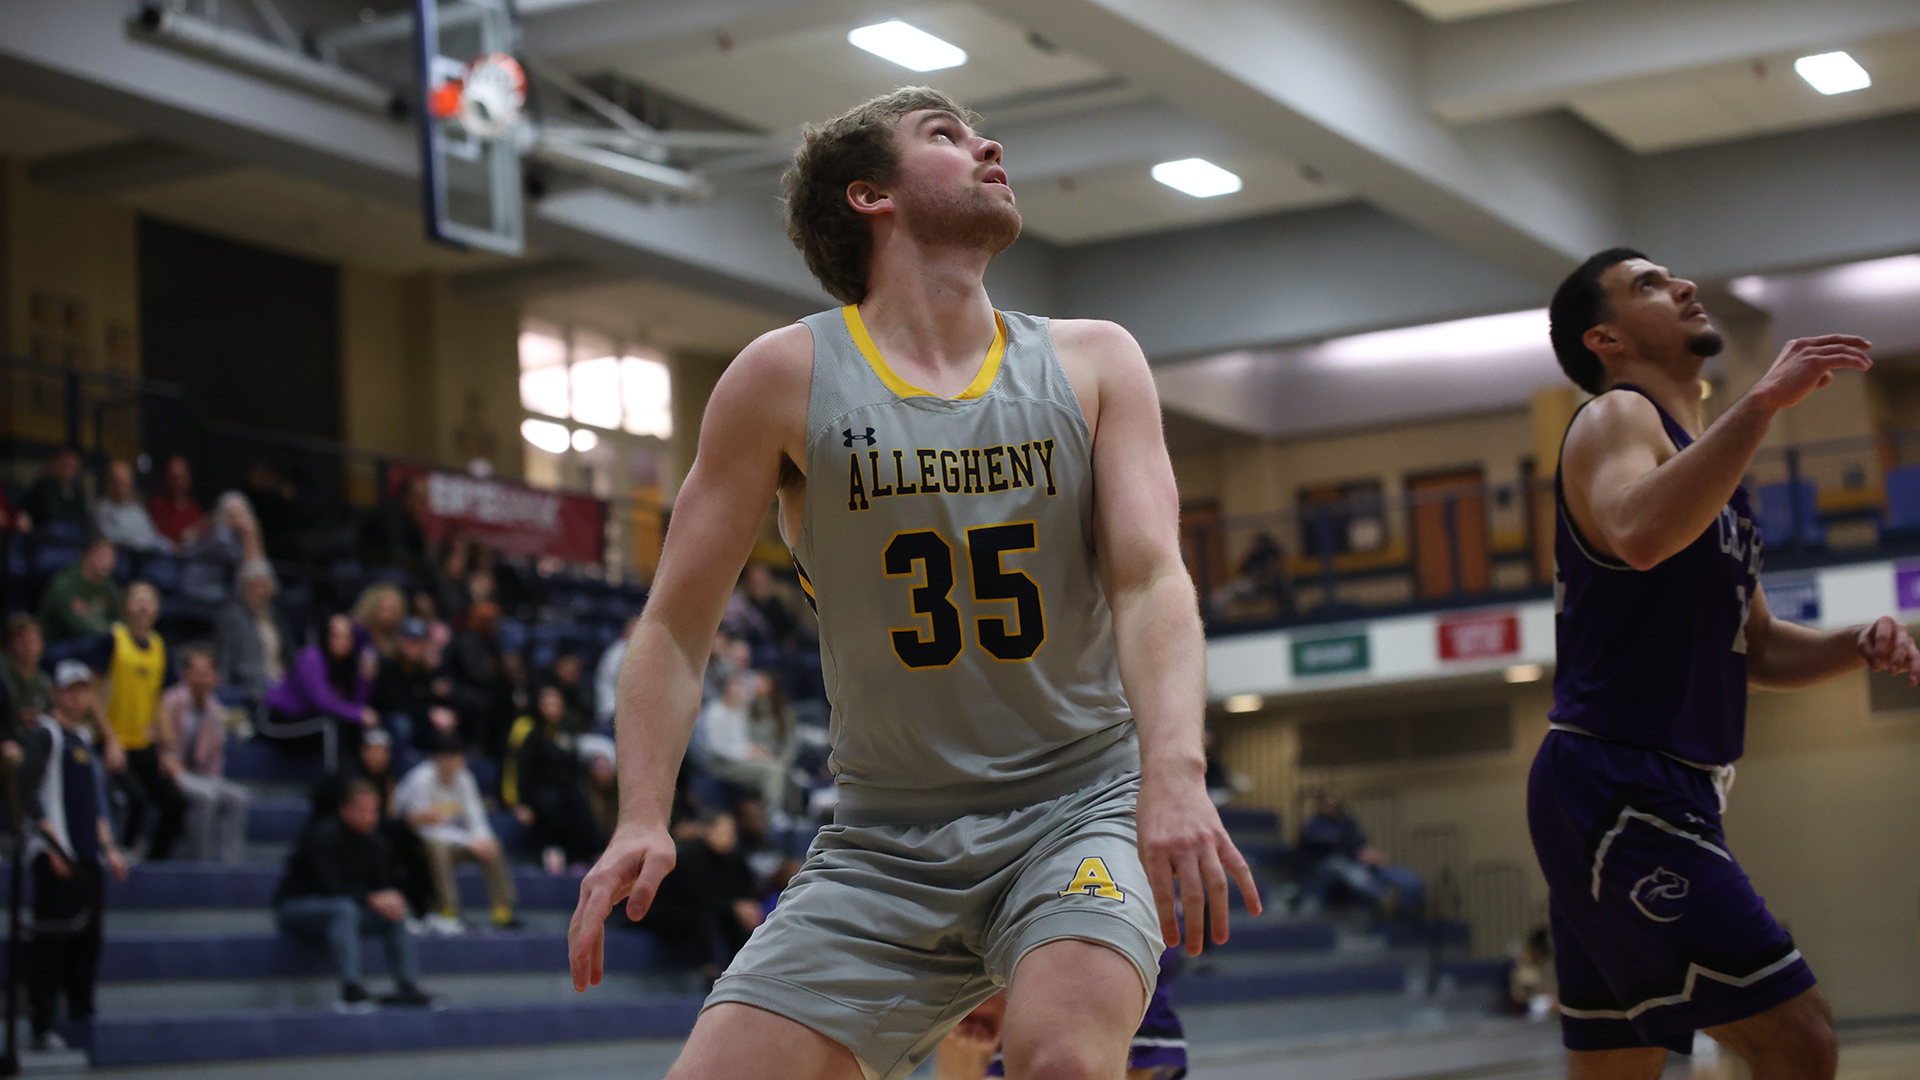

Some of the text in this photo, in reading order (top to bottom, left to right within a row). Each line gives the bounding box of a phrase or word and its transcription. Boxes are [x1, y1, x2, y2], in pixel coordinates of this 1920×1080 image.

[848, 438, 1057, 512] ALLEGHENY
[881, 519, 1047, 672] 35
[1058, 856, 1126, 904] A
